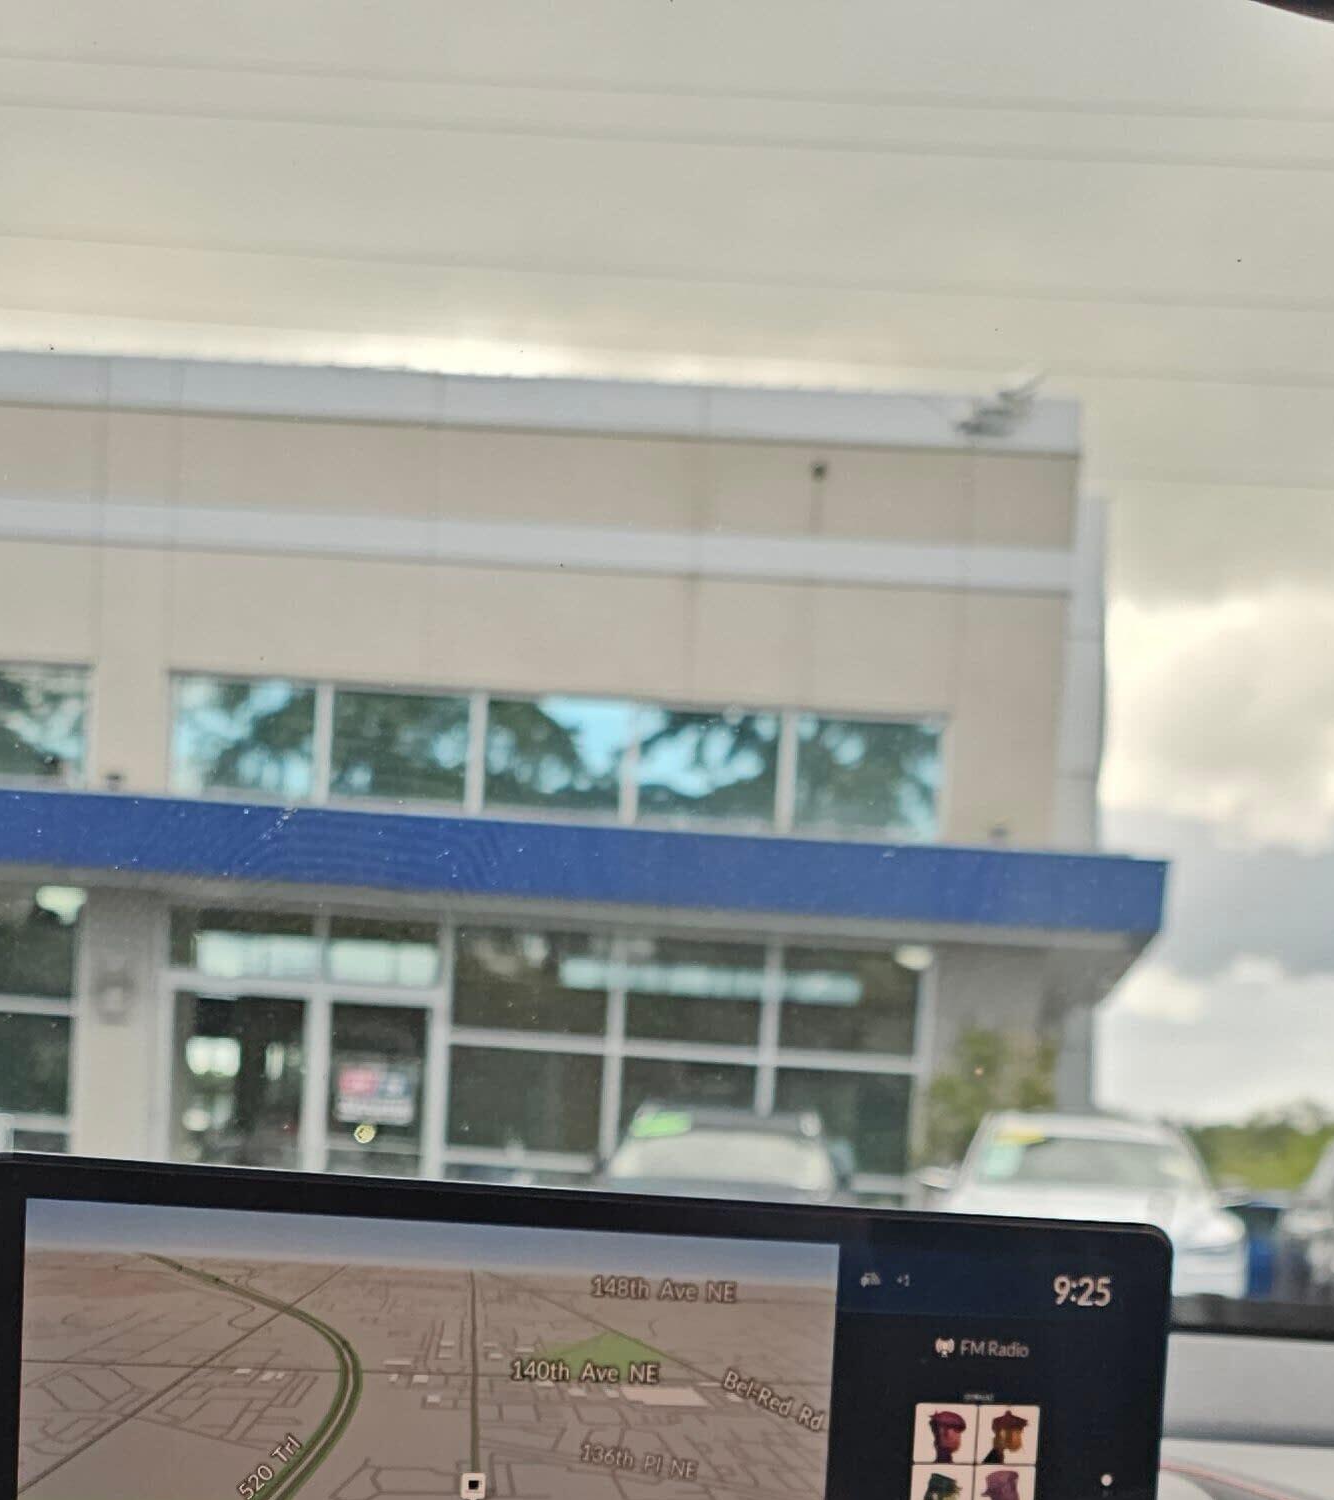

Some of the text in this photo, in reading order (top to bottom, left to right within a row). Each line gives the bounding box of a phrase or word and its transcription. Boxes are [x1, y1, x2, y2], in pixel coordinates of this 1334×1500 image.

[592, 1274, 737, 1302] 148th Ave NE
[1053, 1275, 1112, 1307] 9:25
[960, 1338, 1029, 1358] FM Radio
[513, 1360, 660, 1384] 140th Ave NE
[723, 1370, 824, 1431] Bel-Red Rd
[581, 1443, 633, 1468] 136th
[671, 1458, 698, 1480] NE
[239, 1465, 273, 1500] 520
